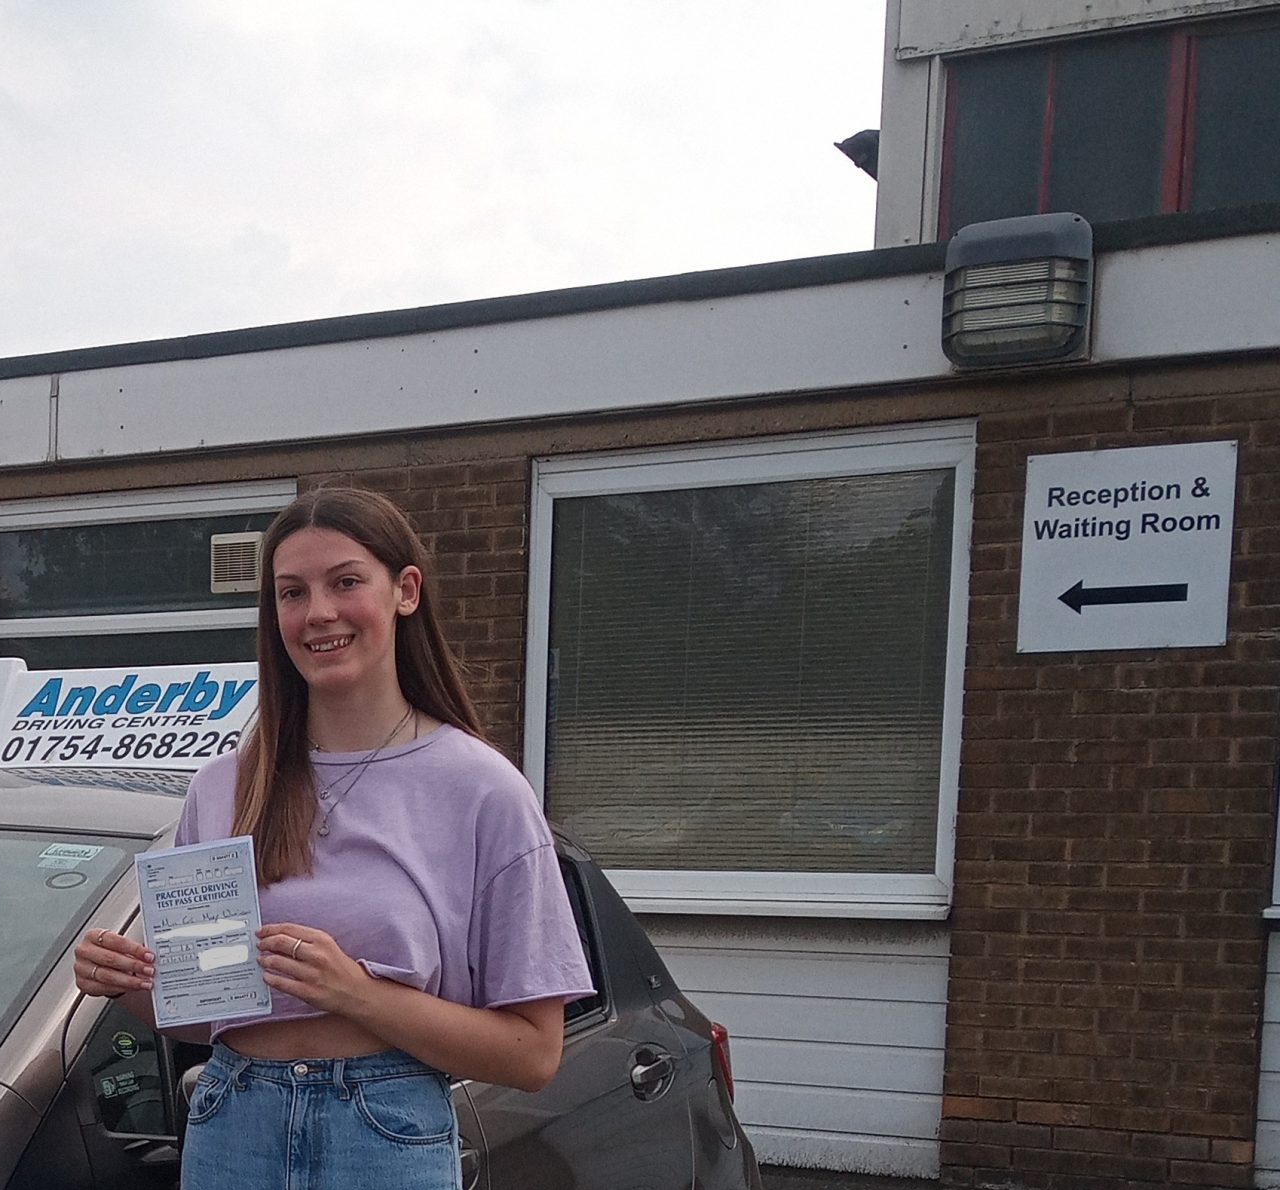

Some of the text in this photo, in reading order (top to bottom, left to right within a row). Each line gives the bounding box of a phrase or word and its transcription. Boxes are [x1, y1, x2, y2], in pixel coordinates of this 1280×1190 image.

[1047, 477, 1211, 508] Reception &
[1034, 512, 1220, 541] Waiting Room
[16, 671, 258, 721] Anderby
[11, 715, 209, 731] DRIVING CENTRE
[1, 730, 242, 762] 01754-868226
[156, 881, 238, 900] PRACTICAL DRIVING
[157, 899, 175, 909] TEST
[175, 896, 193, 906] PASS
[194, 889, 239, 903] CERTIFICATE
